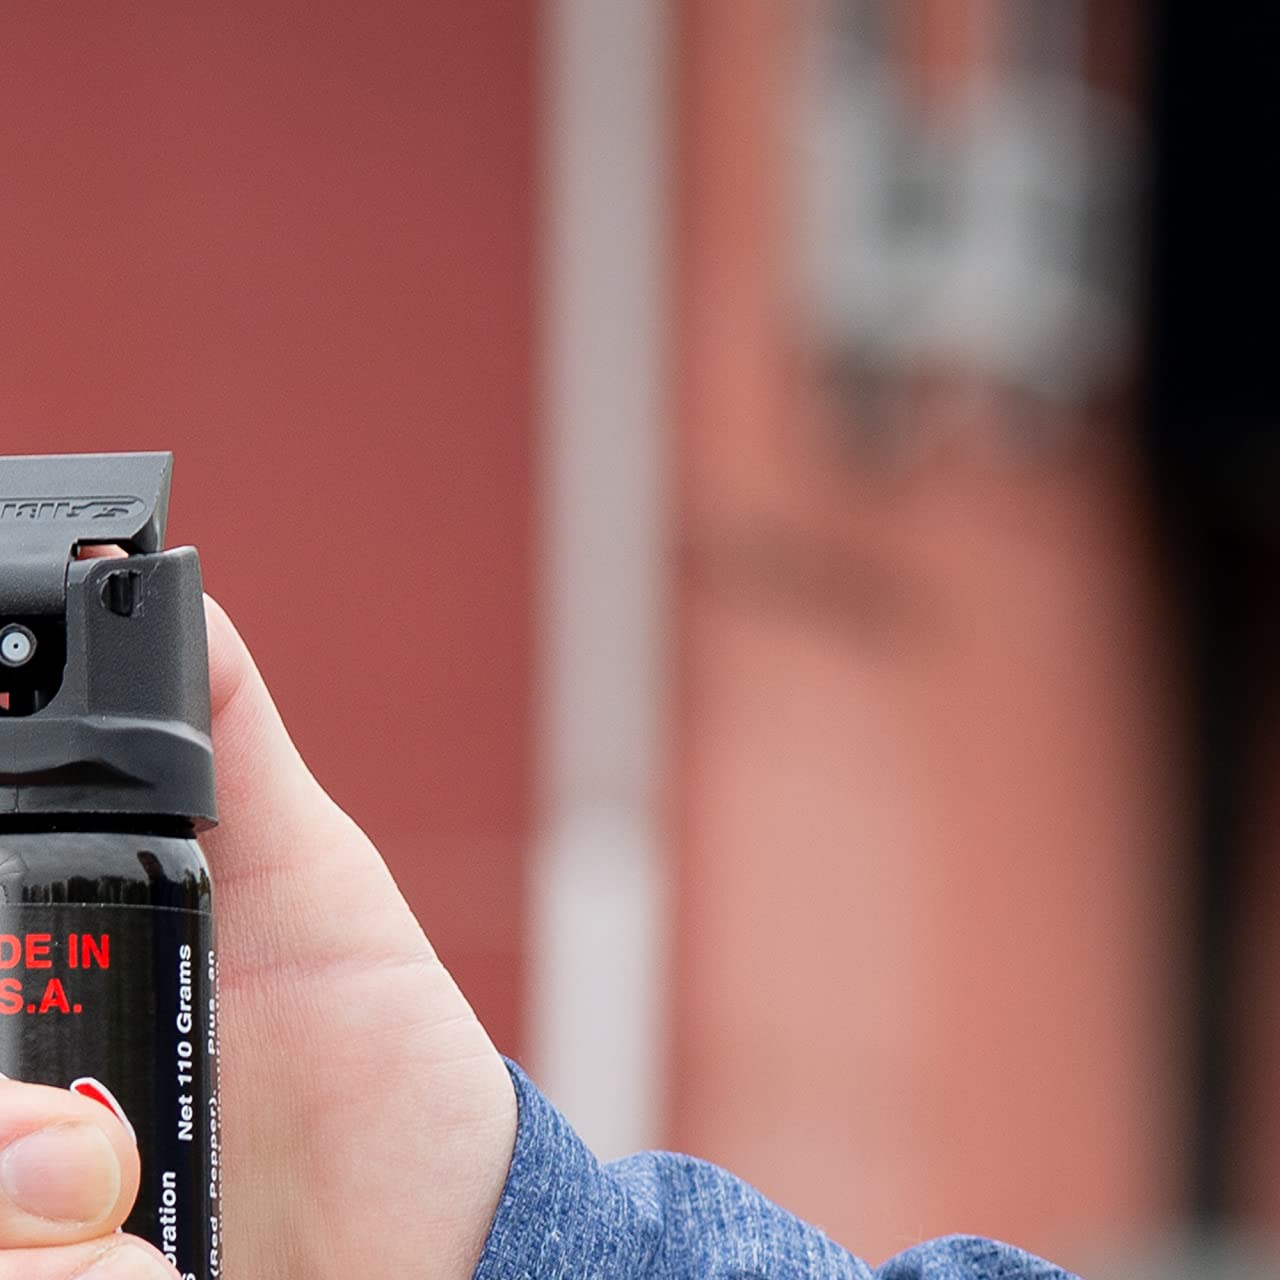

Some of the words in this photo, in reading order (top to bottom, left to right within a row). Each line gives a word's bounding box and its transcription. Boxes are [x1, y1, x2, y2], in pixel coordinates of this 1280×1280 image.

[69, 934, 109, 969] IN
[208, 950, 215, 982] an
[177, 945, 192, 1033] Grams
[178, 1042, 192, 1085] 110
[179, 1095, 192, 1140] Net
[159, 1172, 176, 1264] oration
[210, 1216, 219, 1277] (Red
